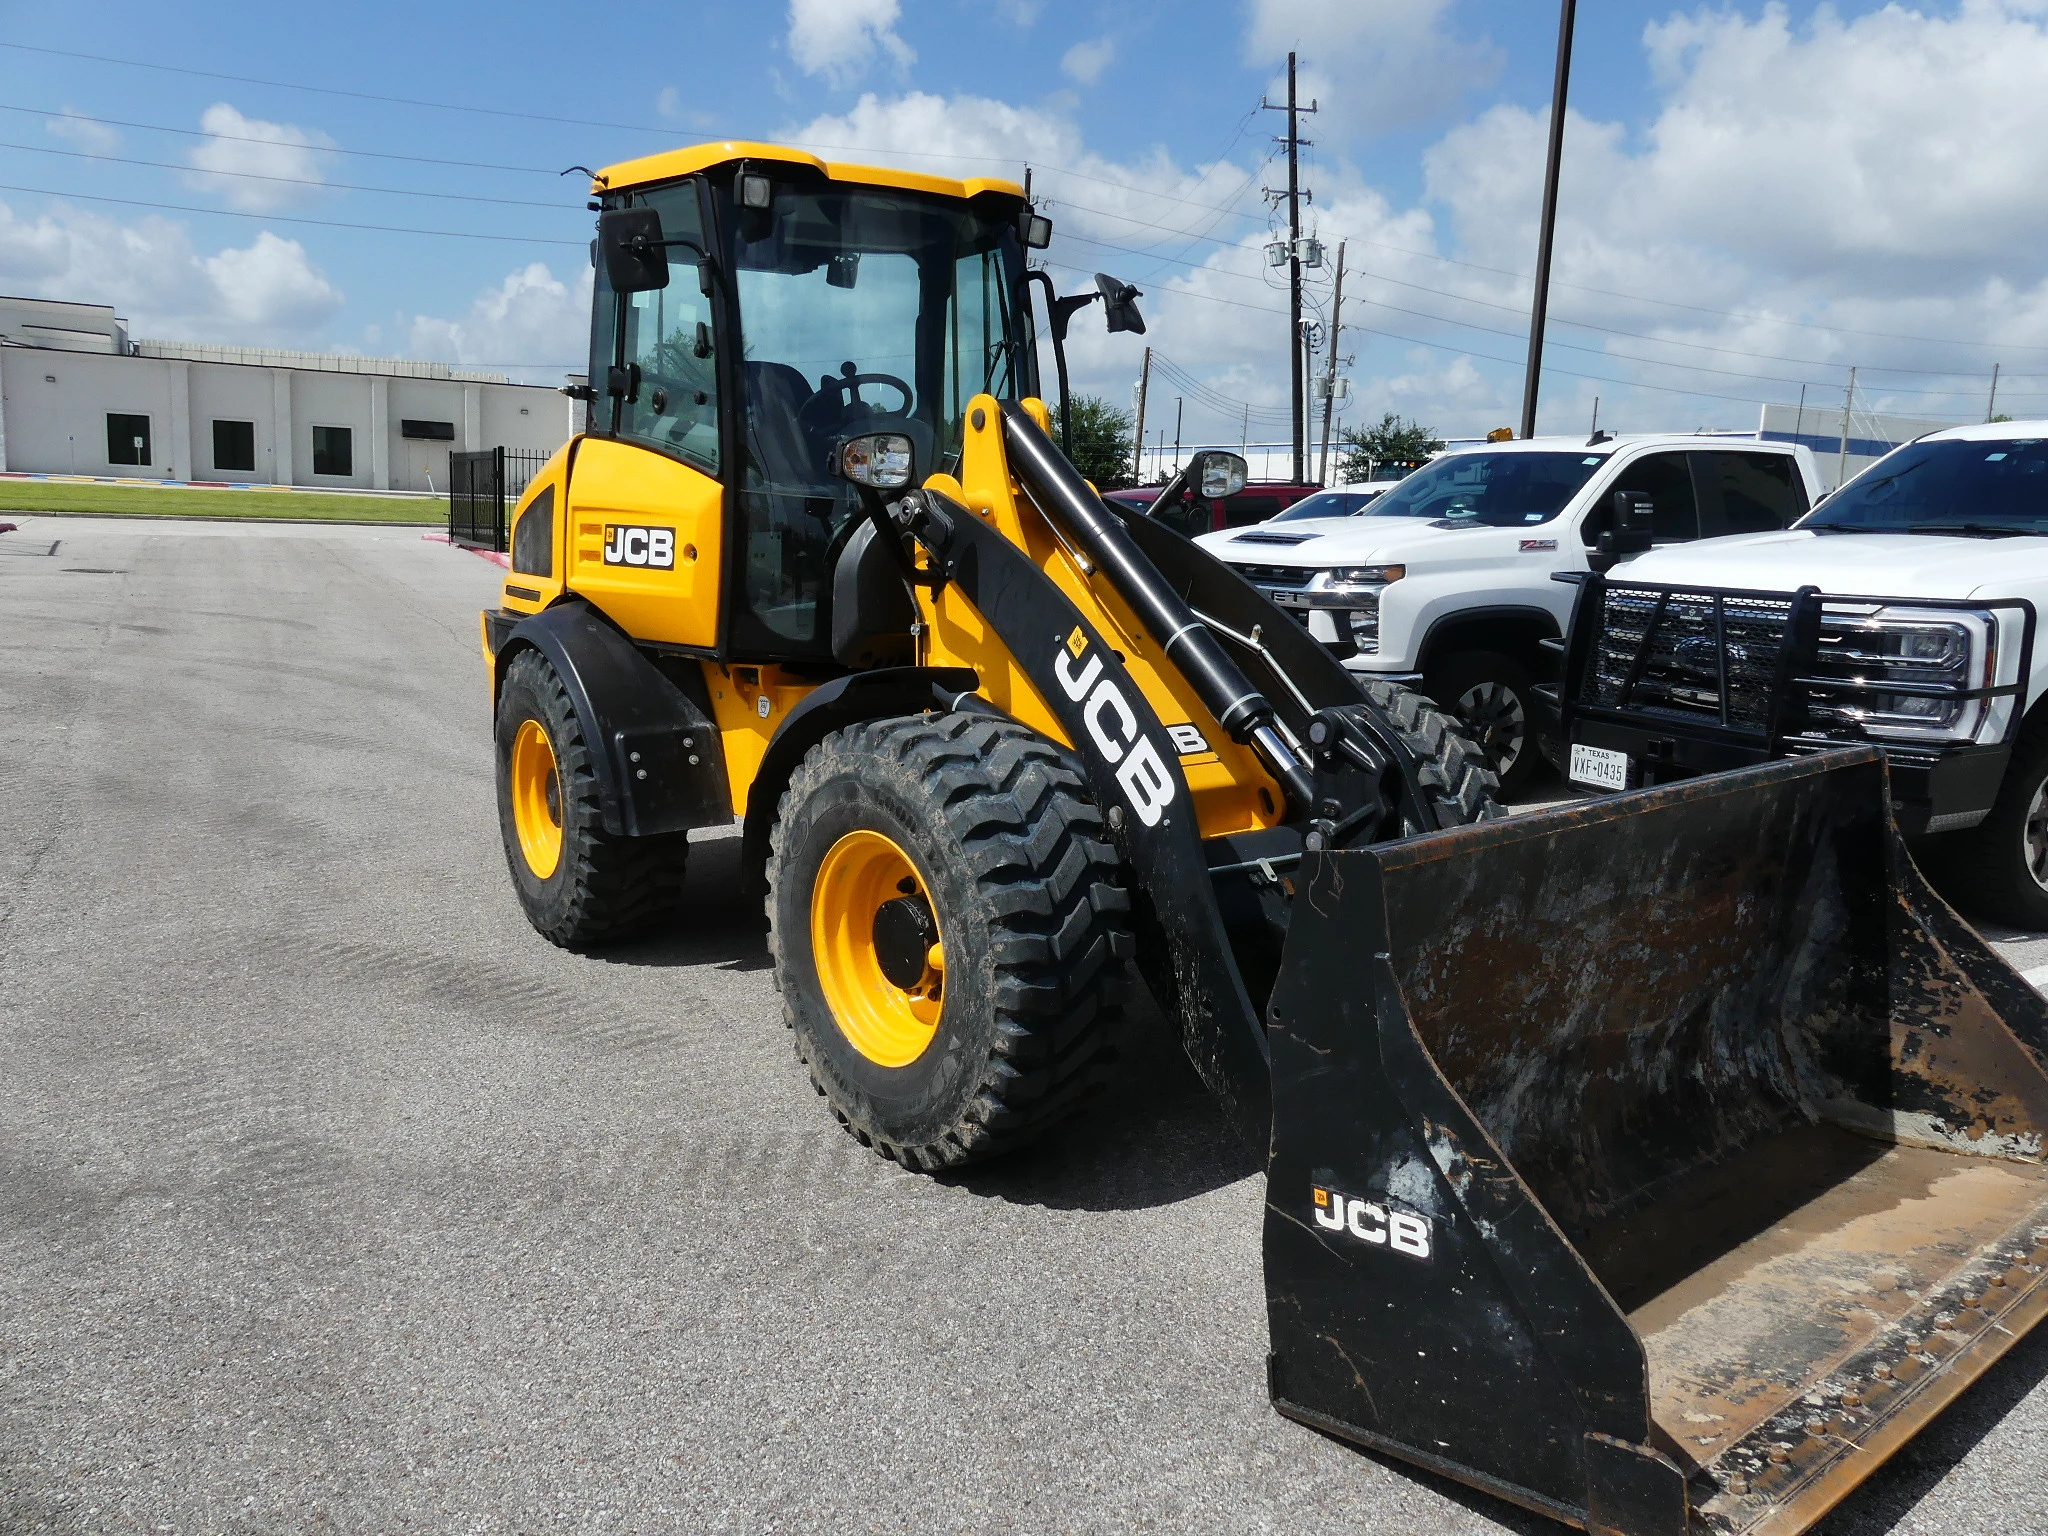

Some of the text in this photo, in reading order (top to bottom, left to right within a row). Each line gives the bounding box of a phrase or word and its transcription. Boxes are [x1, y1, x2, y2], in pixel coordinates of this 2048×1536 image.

[605, 527, 674, 567] JCB
[1054, 648, 1175, 827] JCB
[1165, 724, 1208, 755] B
[1588, 749, 1610, 760] TEXAS
[1315, 1193, 1430, 1258] JCB
